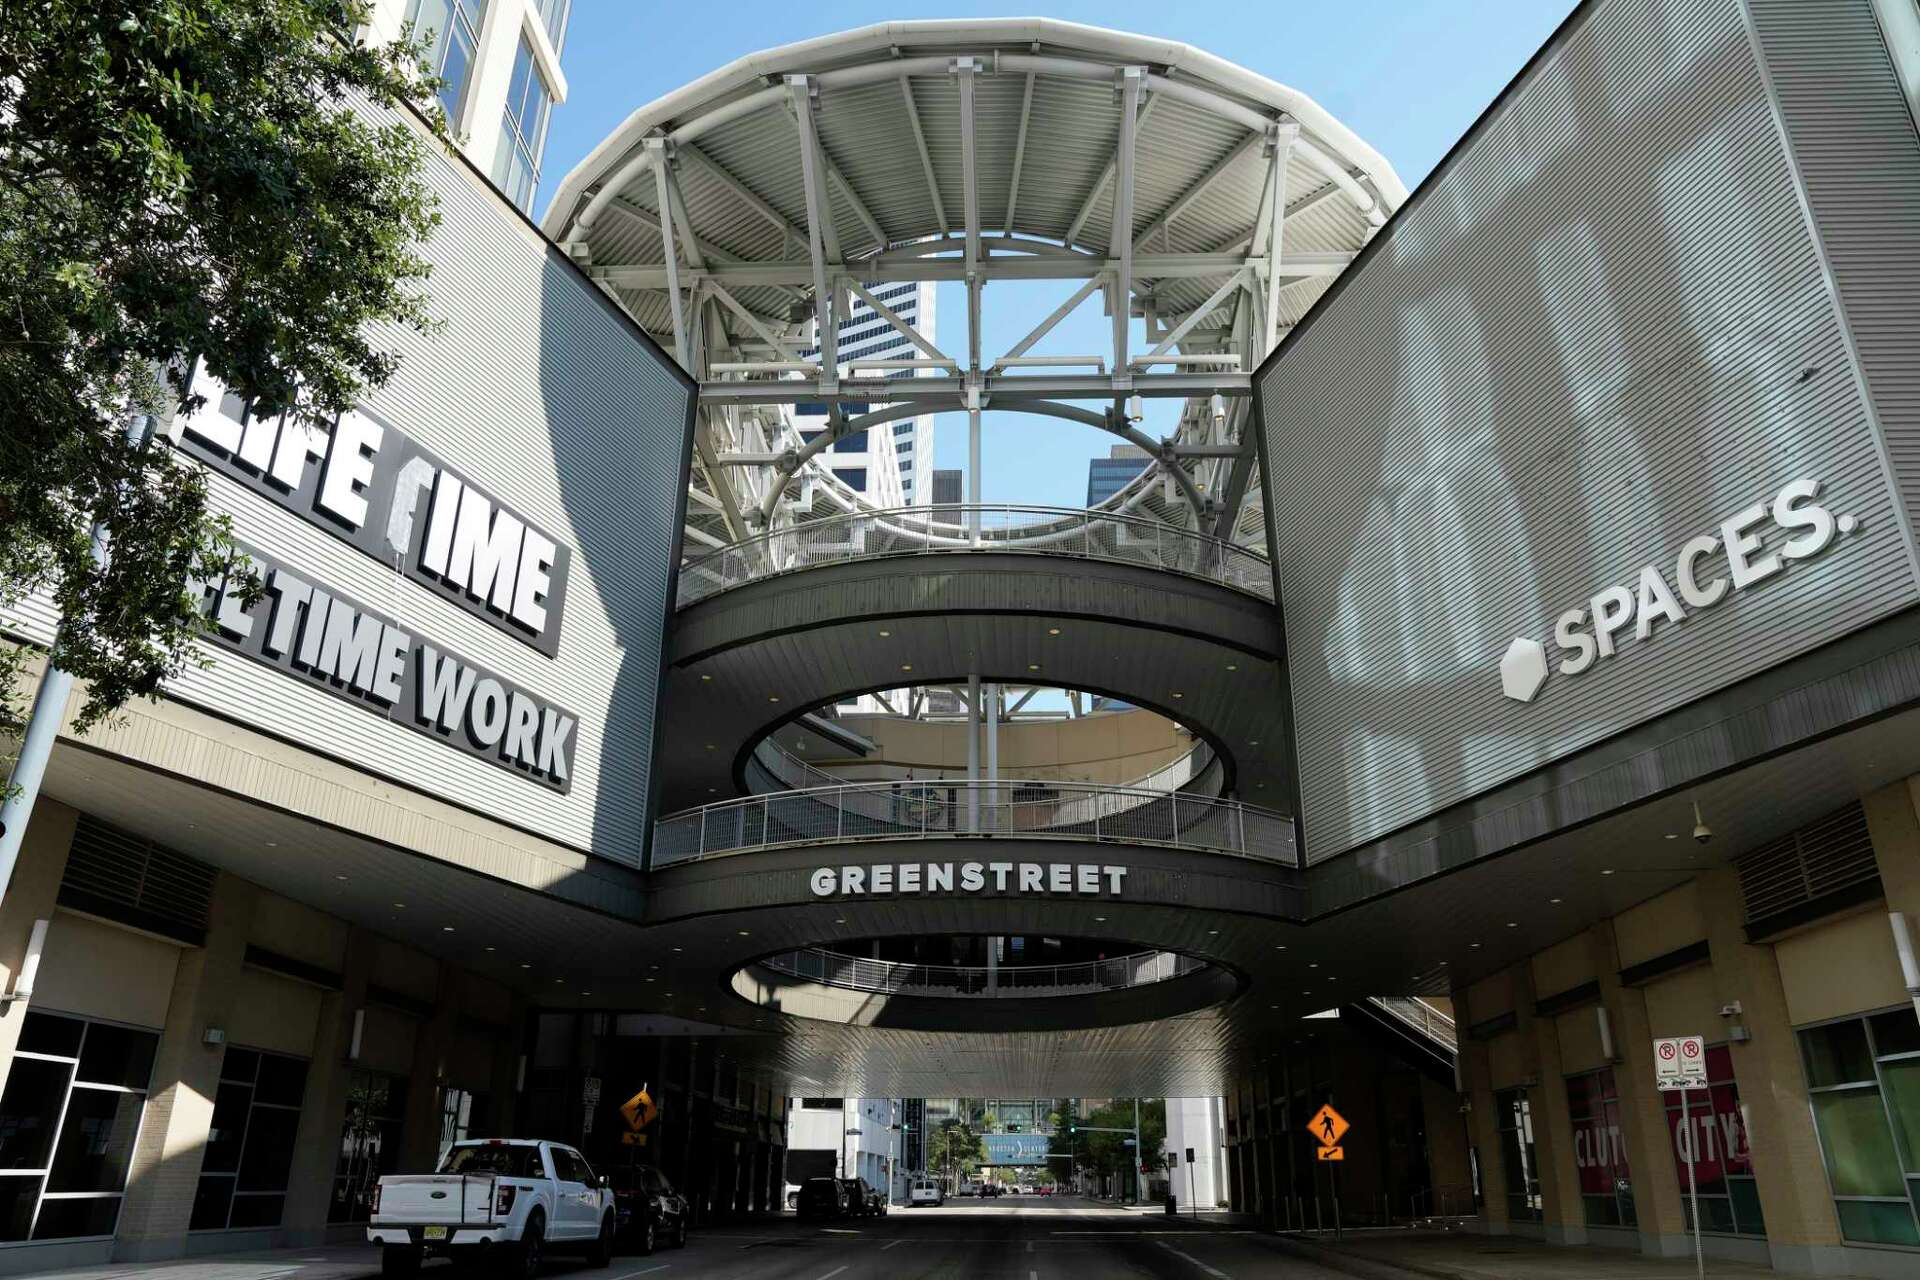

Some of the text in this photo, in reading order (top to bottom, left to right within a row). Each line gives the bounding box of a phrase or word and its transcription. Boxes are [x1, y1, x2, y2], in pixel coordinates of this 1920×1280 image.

[1555, 479, 1858, 675] SPACES.
[272, 569, 410, 705] TIME
[422, 645, 576, 780] WORK
[810, 863, 1127, 896] GREENSTREET
[1575, 1113, 1736, 1167] CLUT CITY
